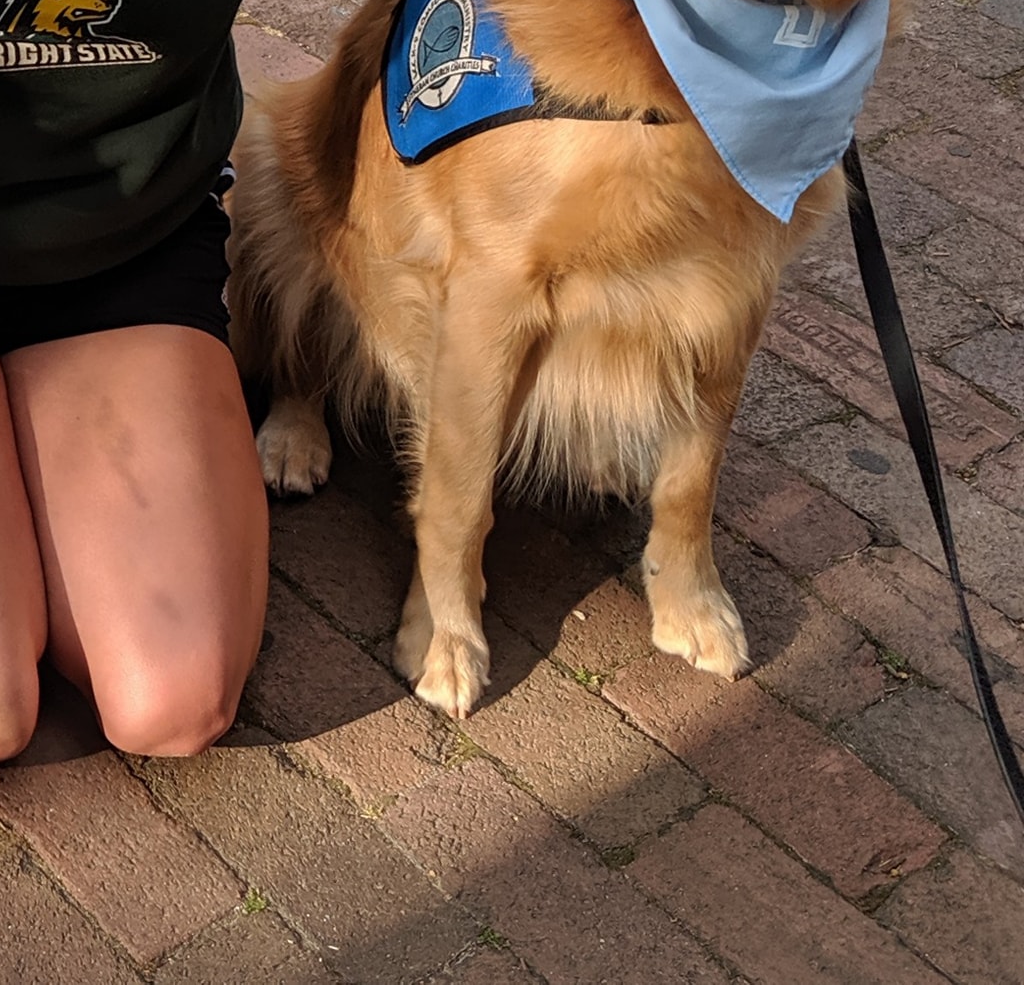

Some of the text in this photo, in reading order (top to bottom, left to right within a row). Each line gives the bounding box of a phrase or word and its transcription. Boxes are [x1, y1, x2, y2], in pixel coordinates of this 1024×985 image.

[77, 43, 151, 63] STATE
[429, 63, 451, 83] CHURCH
[450, 60, 480, 74] CHARITIES
